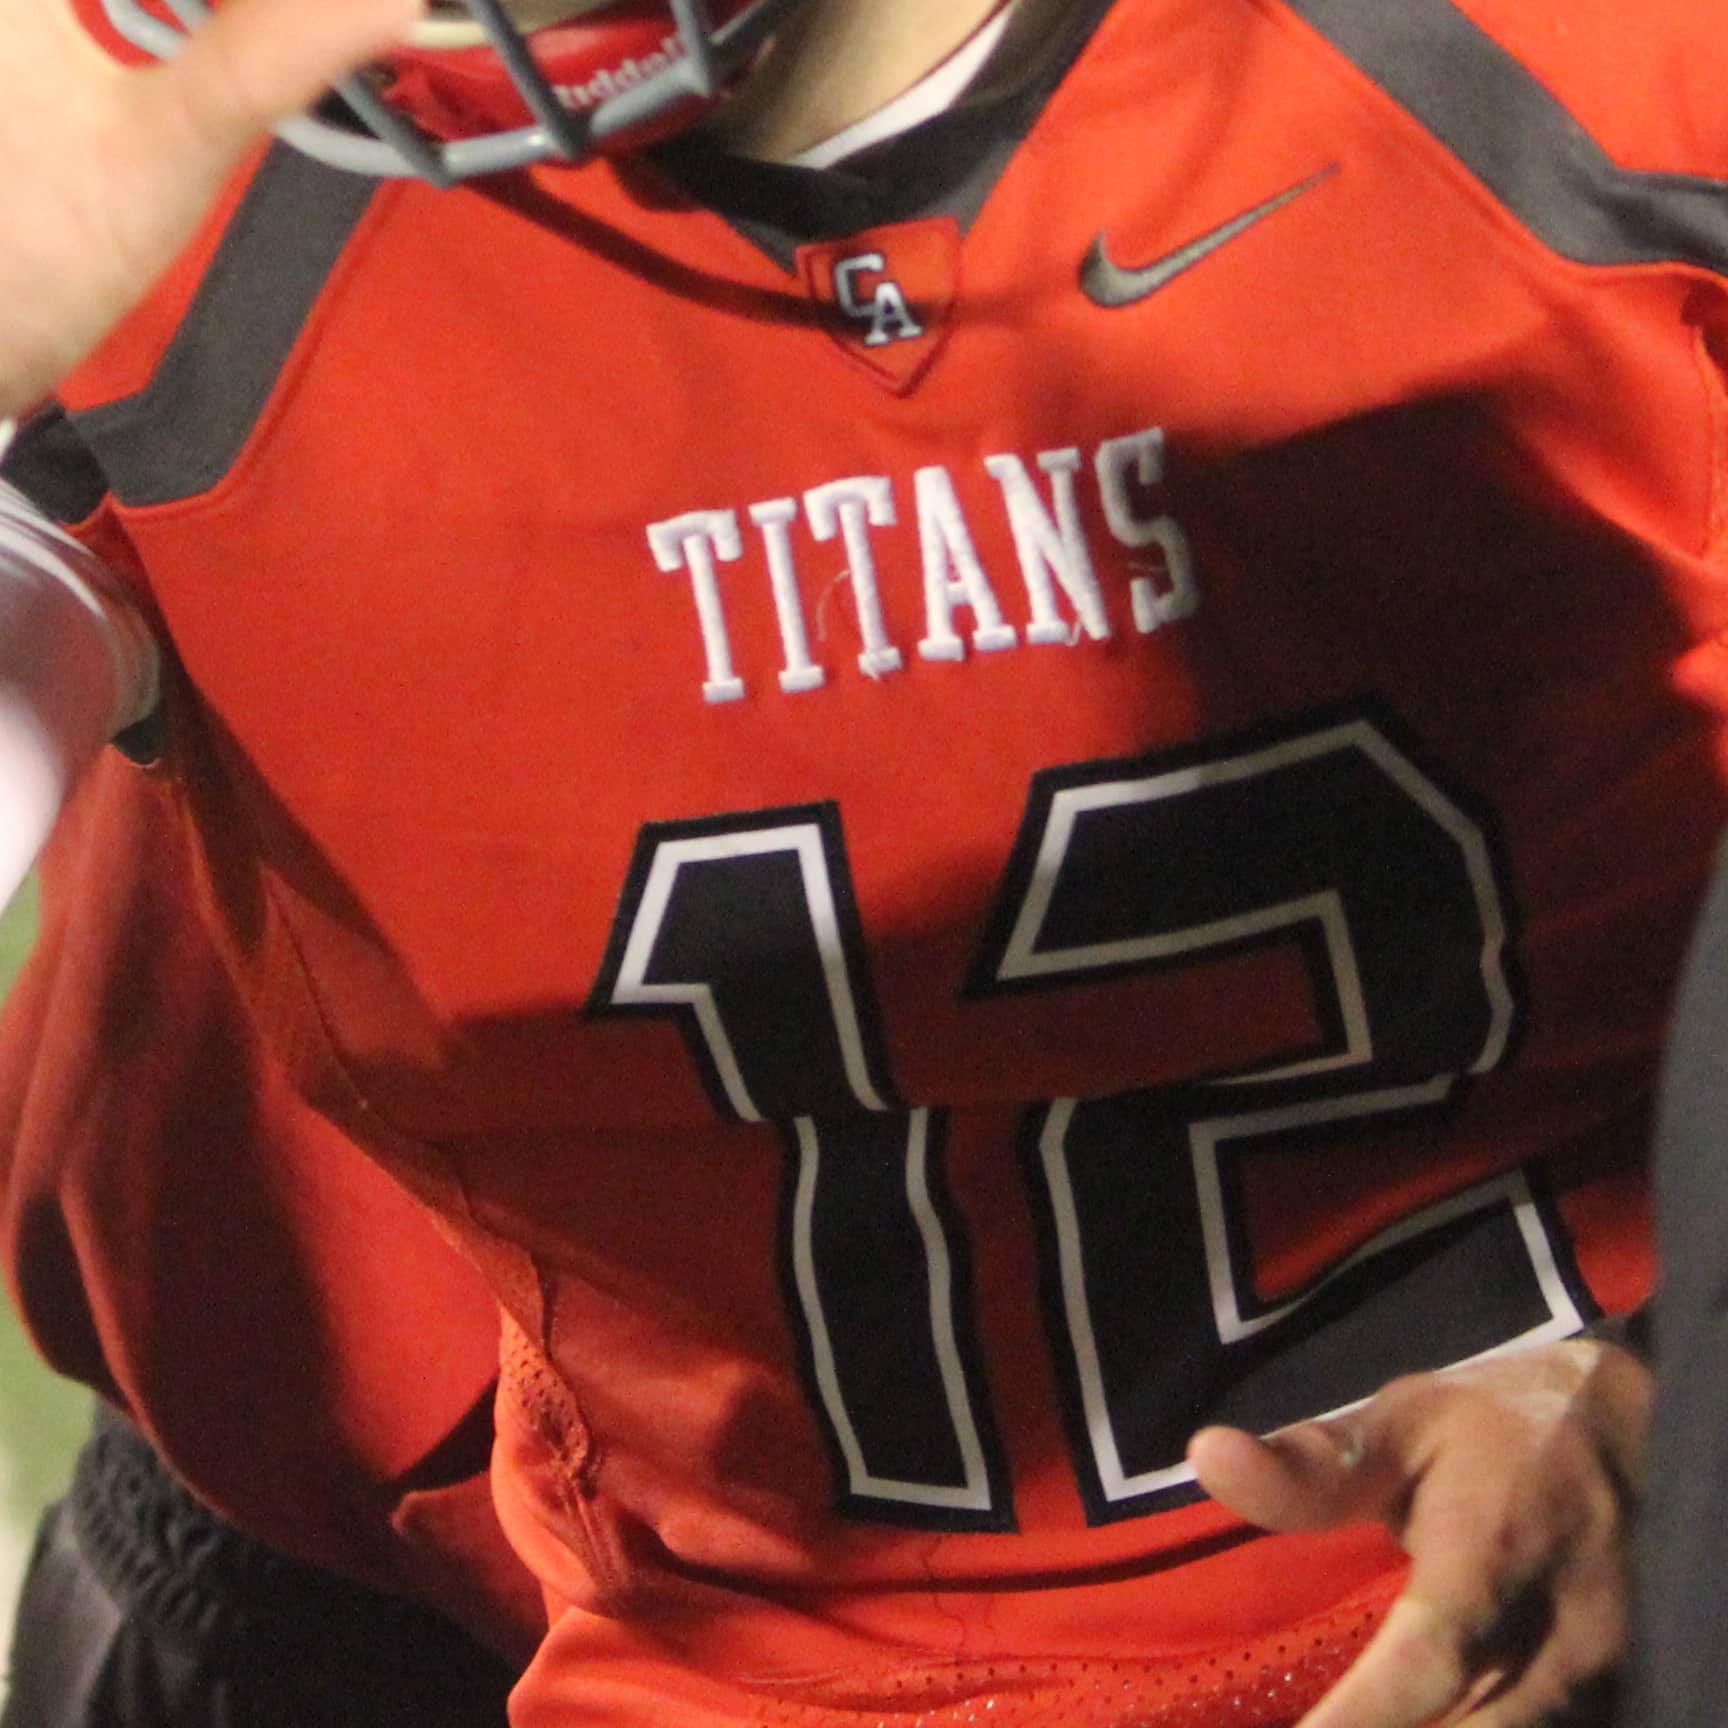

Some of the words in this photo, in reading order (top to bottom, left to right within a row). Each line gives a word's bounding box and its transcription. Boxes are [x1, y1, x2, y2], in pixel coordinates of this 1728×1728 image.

[832, 251, 924, 347] CA
[646, 426, 1200, 704] TITANS
[582, 692, 1602, 1534] 12
